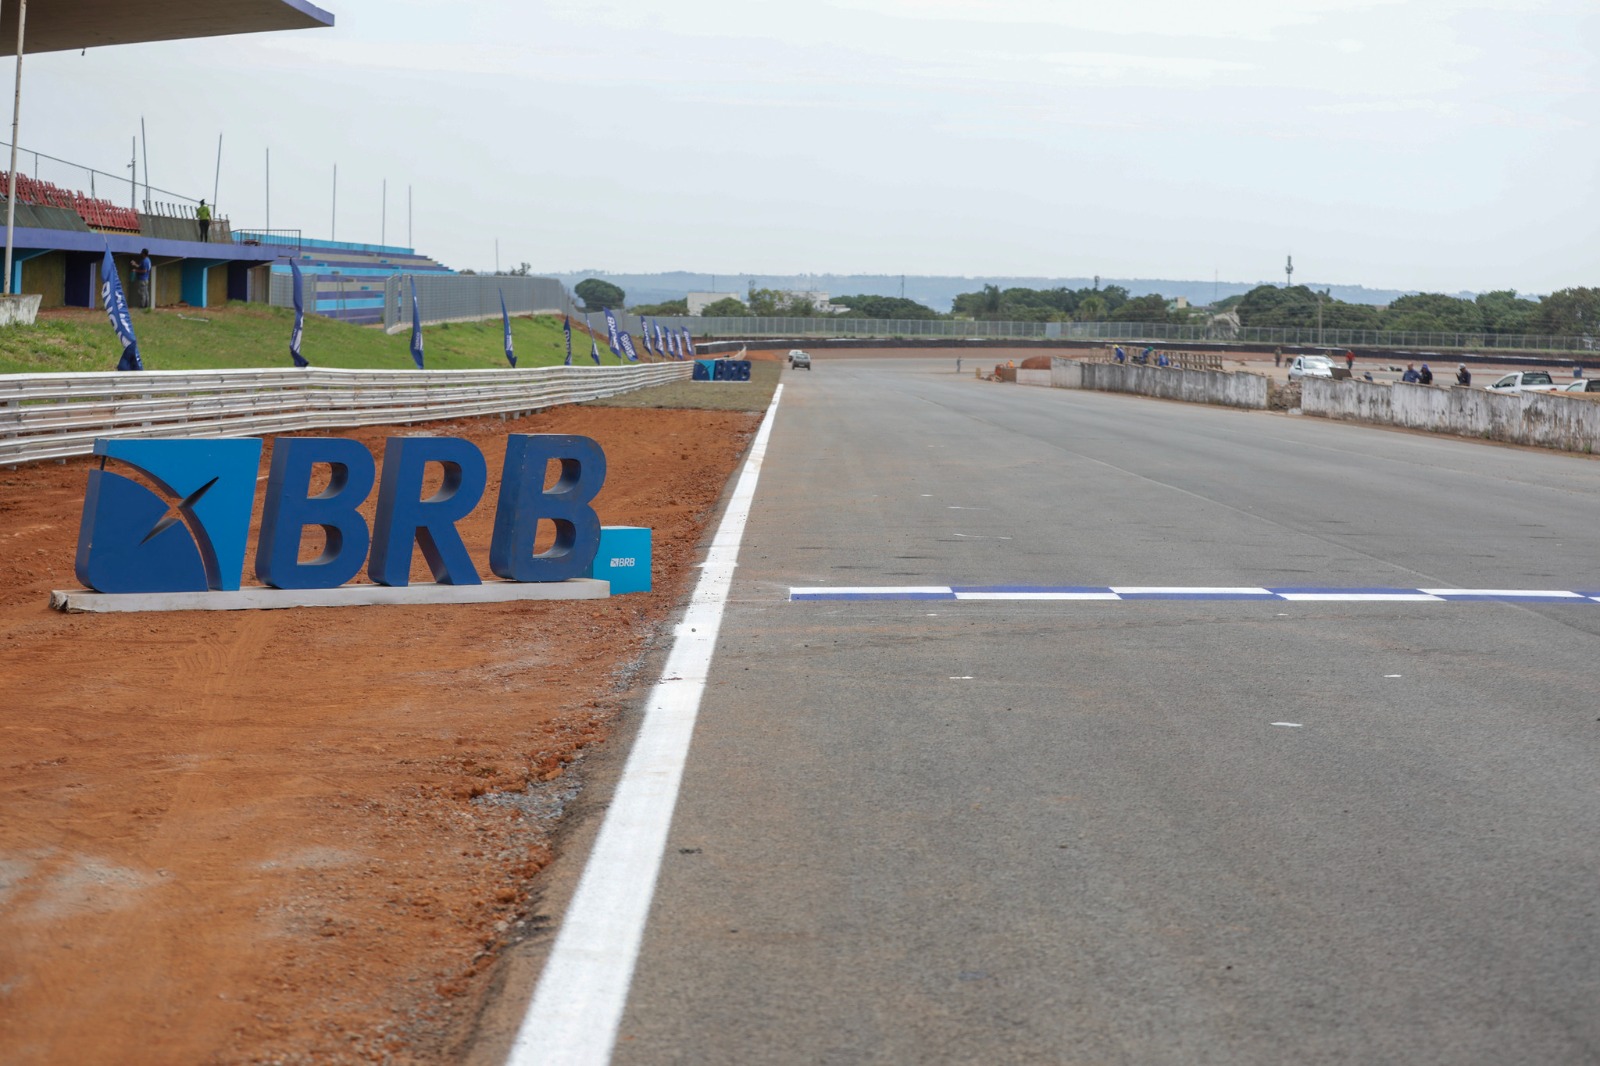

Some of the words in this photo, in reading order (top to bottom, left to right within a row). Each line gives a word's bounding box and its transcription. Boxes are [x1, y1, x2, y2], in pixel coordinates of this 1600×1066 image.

[715, 360, 752, 381] BRB
[255, 433, 606, 589] BRB
[619, 558, 635, 566] BRB
